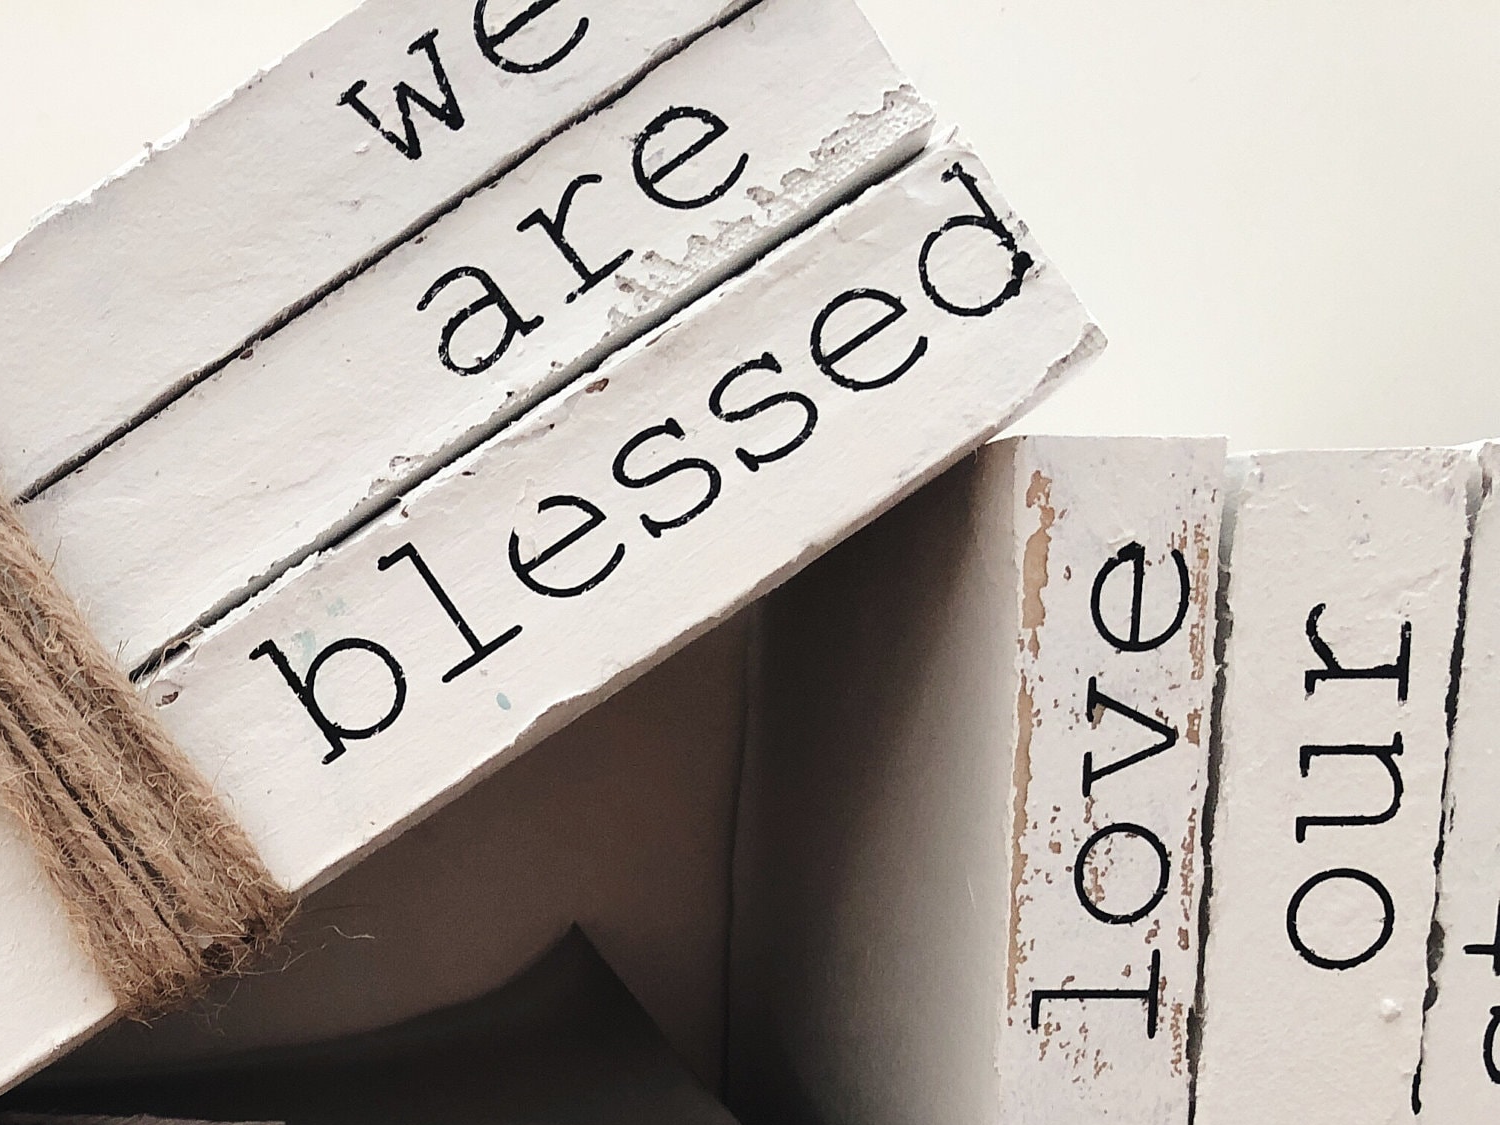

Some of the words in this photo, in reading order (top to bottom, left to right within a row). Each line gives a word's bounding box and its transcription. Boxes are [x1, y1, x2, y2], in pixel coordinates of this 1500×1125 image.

[336, 0, 590, 160] we
[416, 104, 750, 377] are
[248, 161, 1035, 765] blessed
[1029, 540, 1191, 1040] love
[1286, 602, 1412, 971] our
